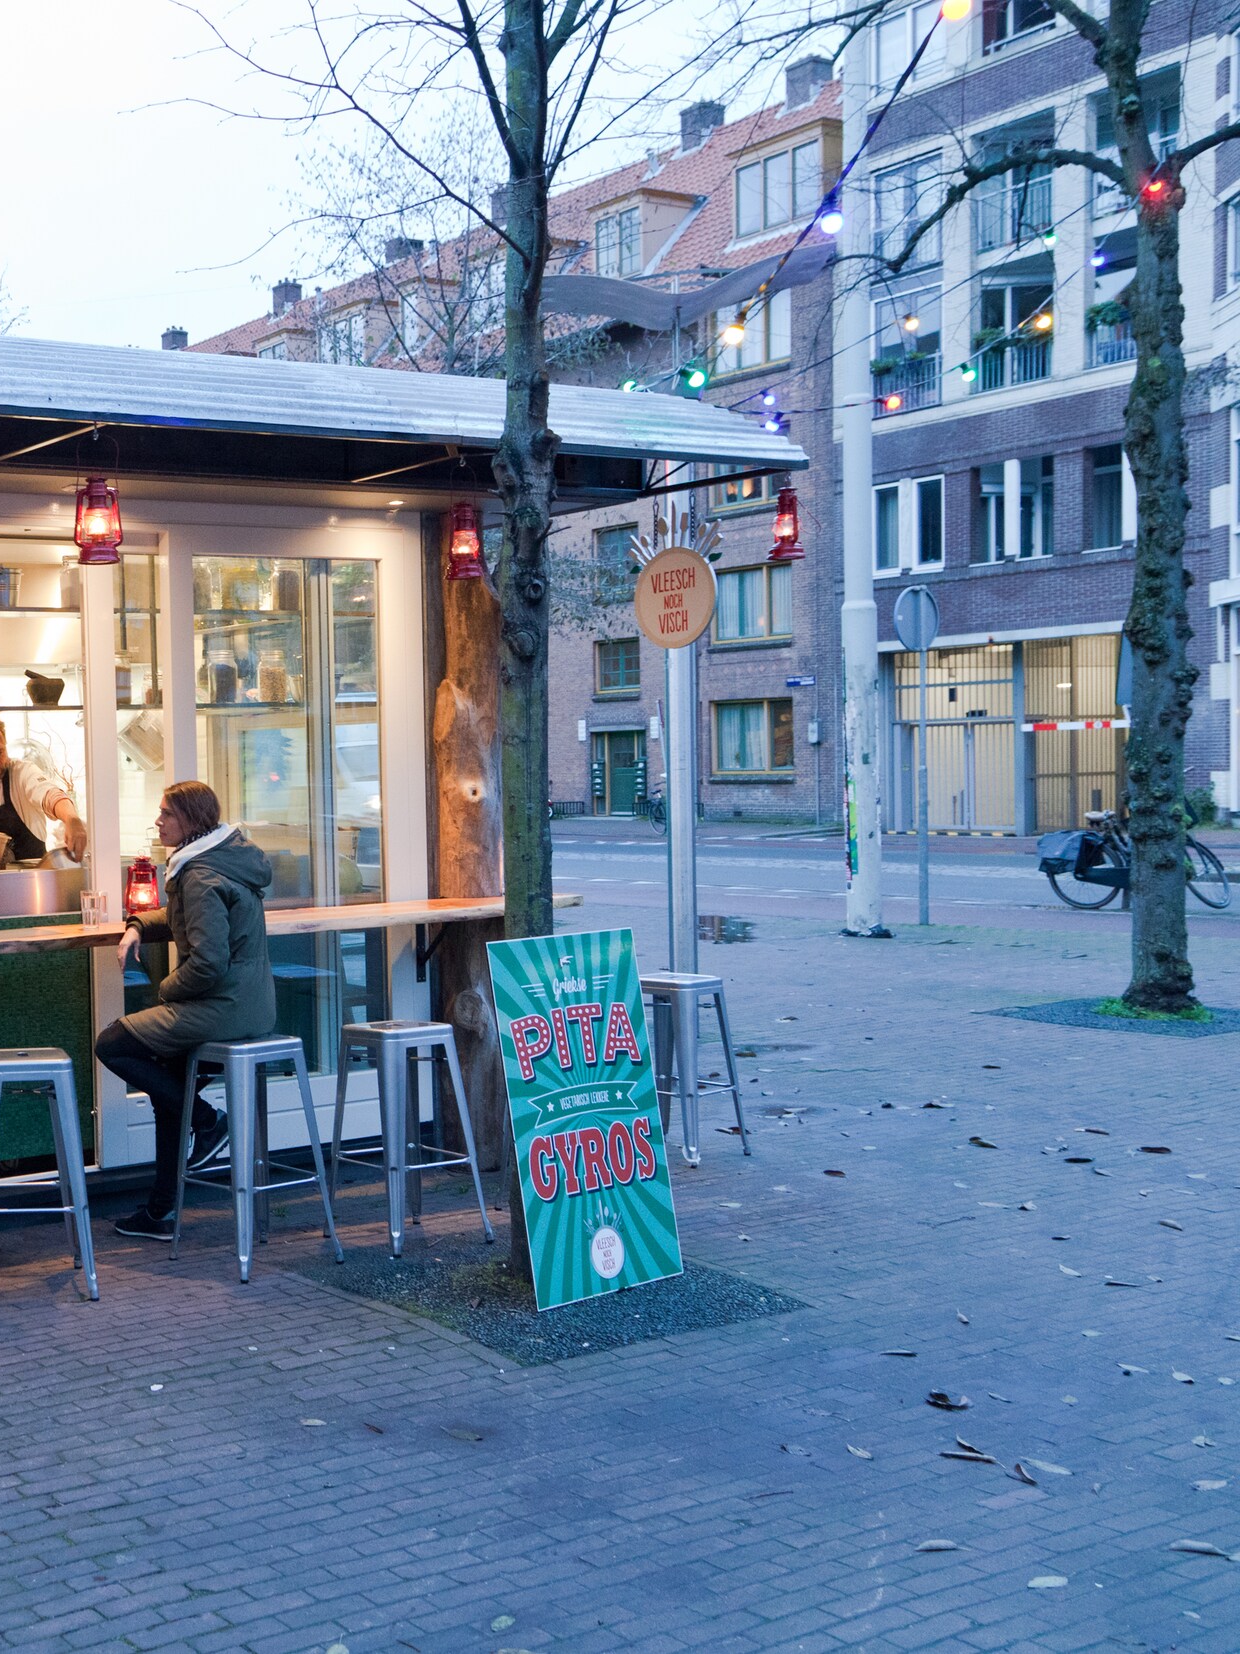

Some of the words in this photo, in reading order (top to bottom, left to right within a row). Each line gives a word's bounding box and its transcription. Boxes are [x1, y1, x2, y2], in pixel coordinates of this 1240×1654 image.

[651, 567, 696, 594] VLEESCH
[663, 593, 683, 609] NOCH
[658, 610, 689, 634] VISCH
[552, 975, 587, 1002] Griekse
[510, 1002, 642, 1081] PITA
[559, 1093, 590, 1110] VEGETARISCH
[529, 1116, 656, 1201] GYROS
